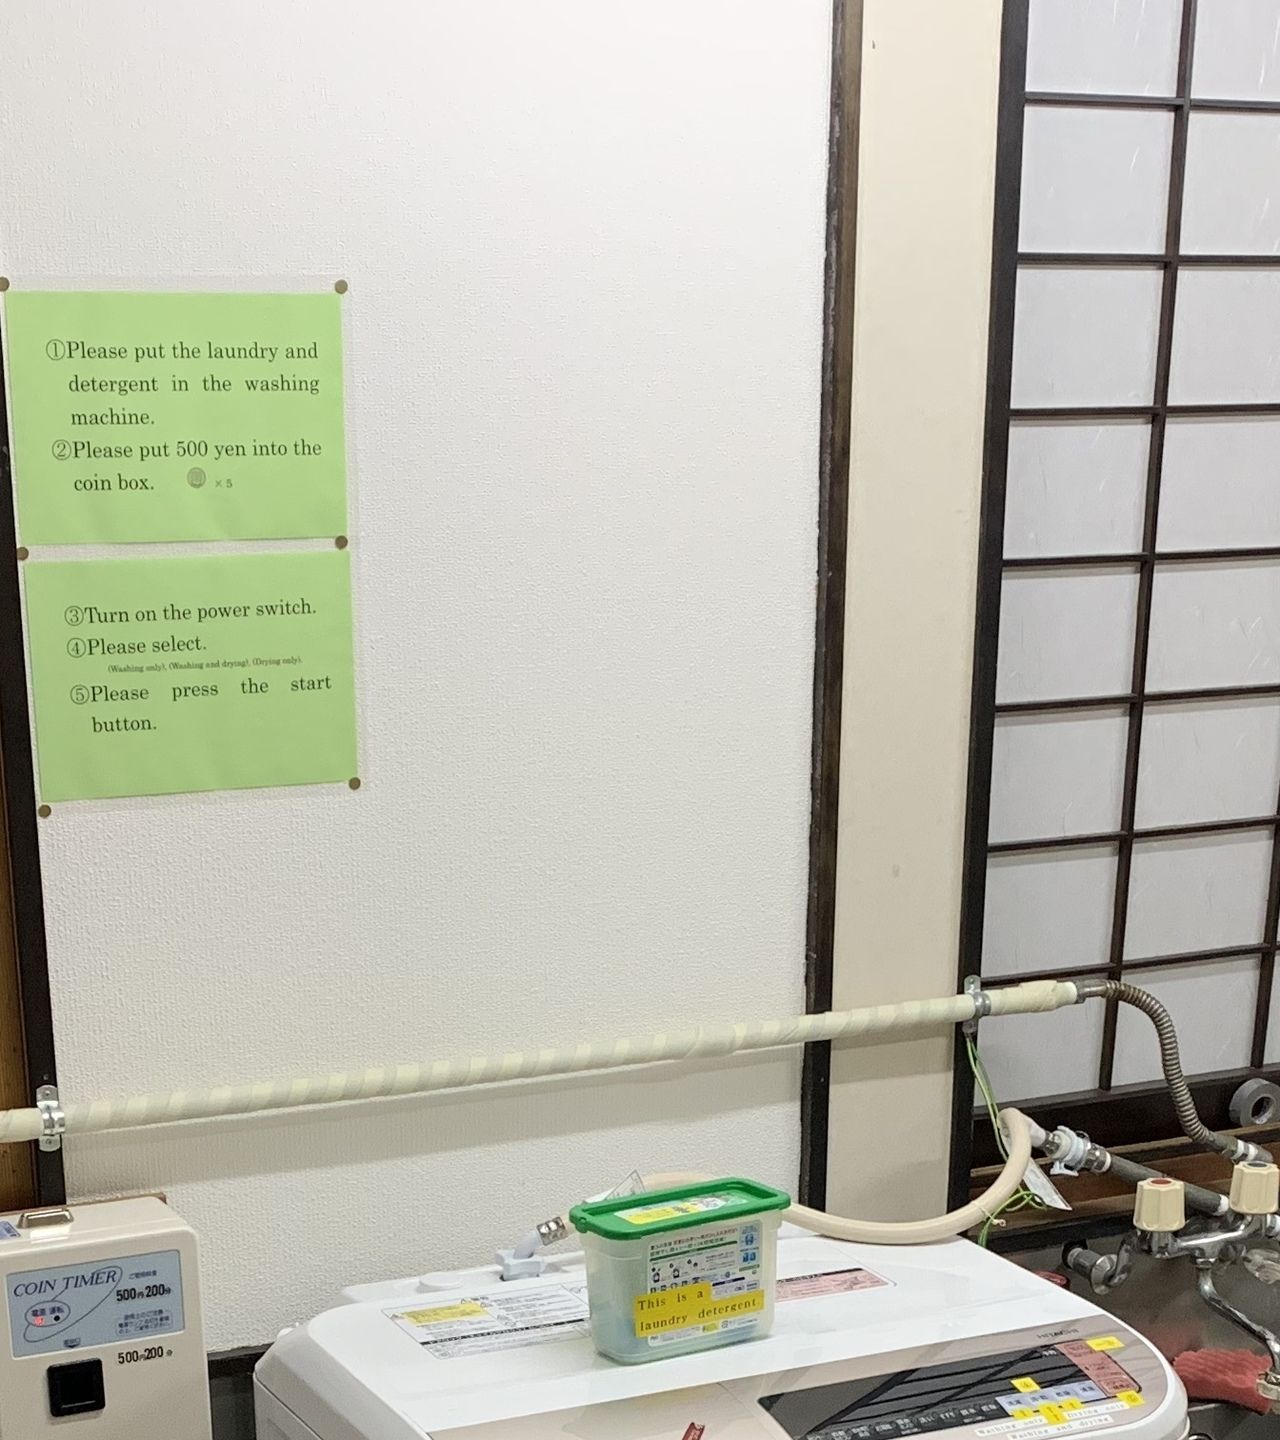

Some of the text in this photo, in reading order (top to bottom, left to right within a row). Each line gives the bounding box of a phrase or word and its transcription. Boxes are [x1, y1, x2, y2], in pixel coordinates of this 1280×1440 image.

[46, 339, 319, 362] ①Please put the laundry and
[68, 375, 320, 396] detergent in the washing
[71, 407, 155, 425] machine.
[52, 439, 322, 461] ②Please put 500 yen into the
[74, 473, 111, 491] coin
[118, 473, 154, 490] box.
[64, 598, 317, 626] ③Turn on the power switch.
[66, 635, 207, 658] ④Please select.
[205, 659, 220, 668] and
[70, 675, 332, 705] ⑤Please press the start
[92, 716, 157, 733] button.
[13, 1279, 56, 1298] COIN
[63, 1269, 117, 1290] TIMER
[637, 1289, 704, 1312] This is a
[640, 1315, 688, 1332] laundry
[978, 1424, 1017, 1436] Washing
[1011, 1429, 1049, 1440] Washing
